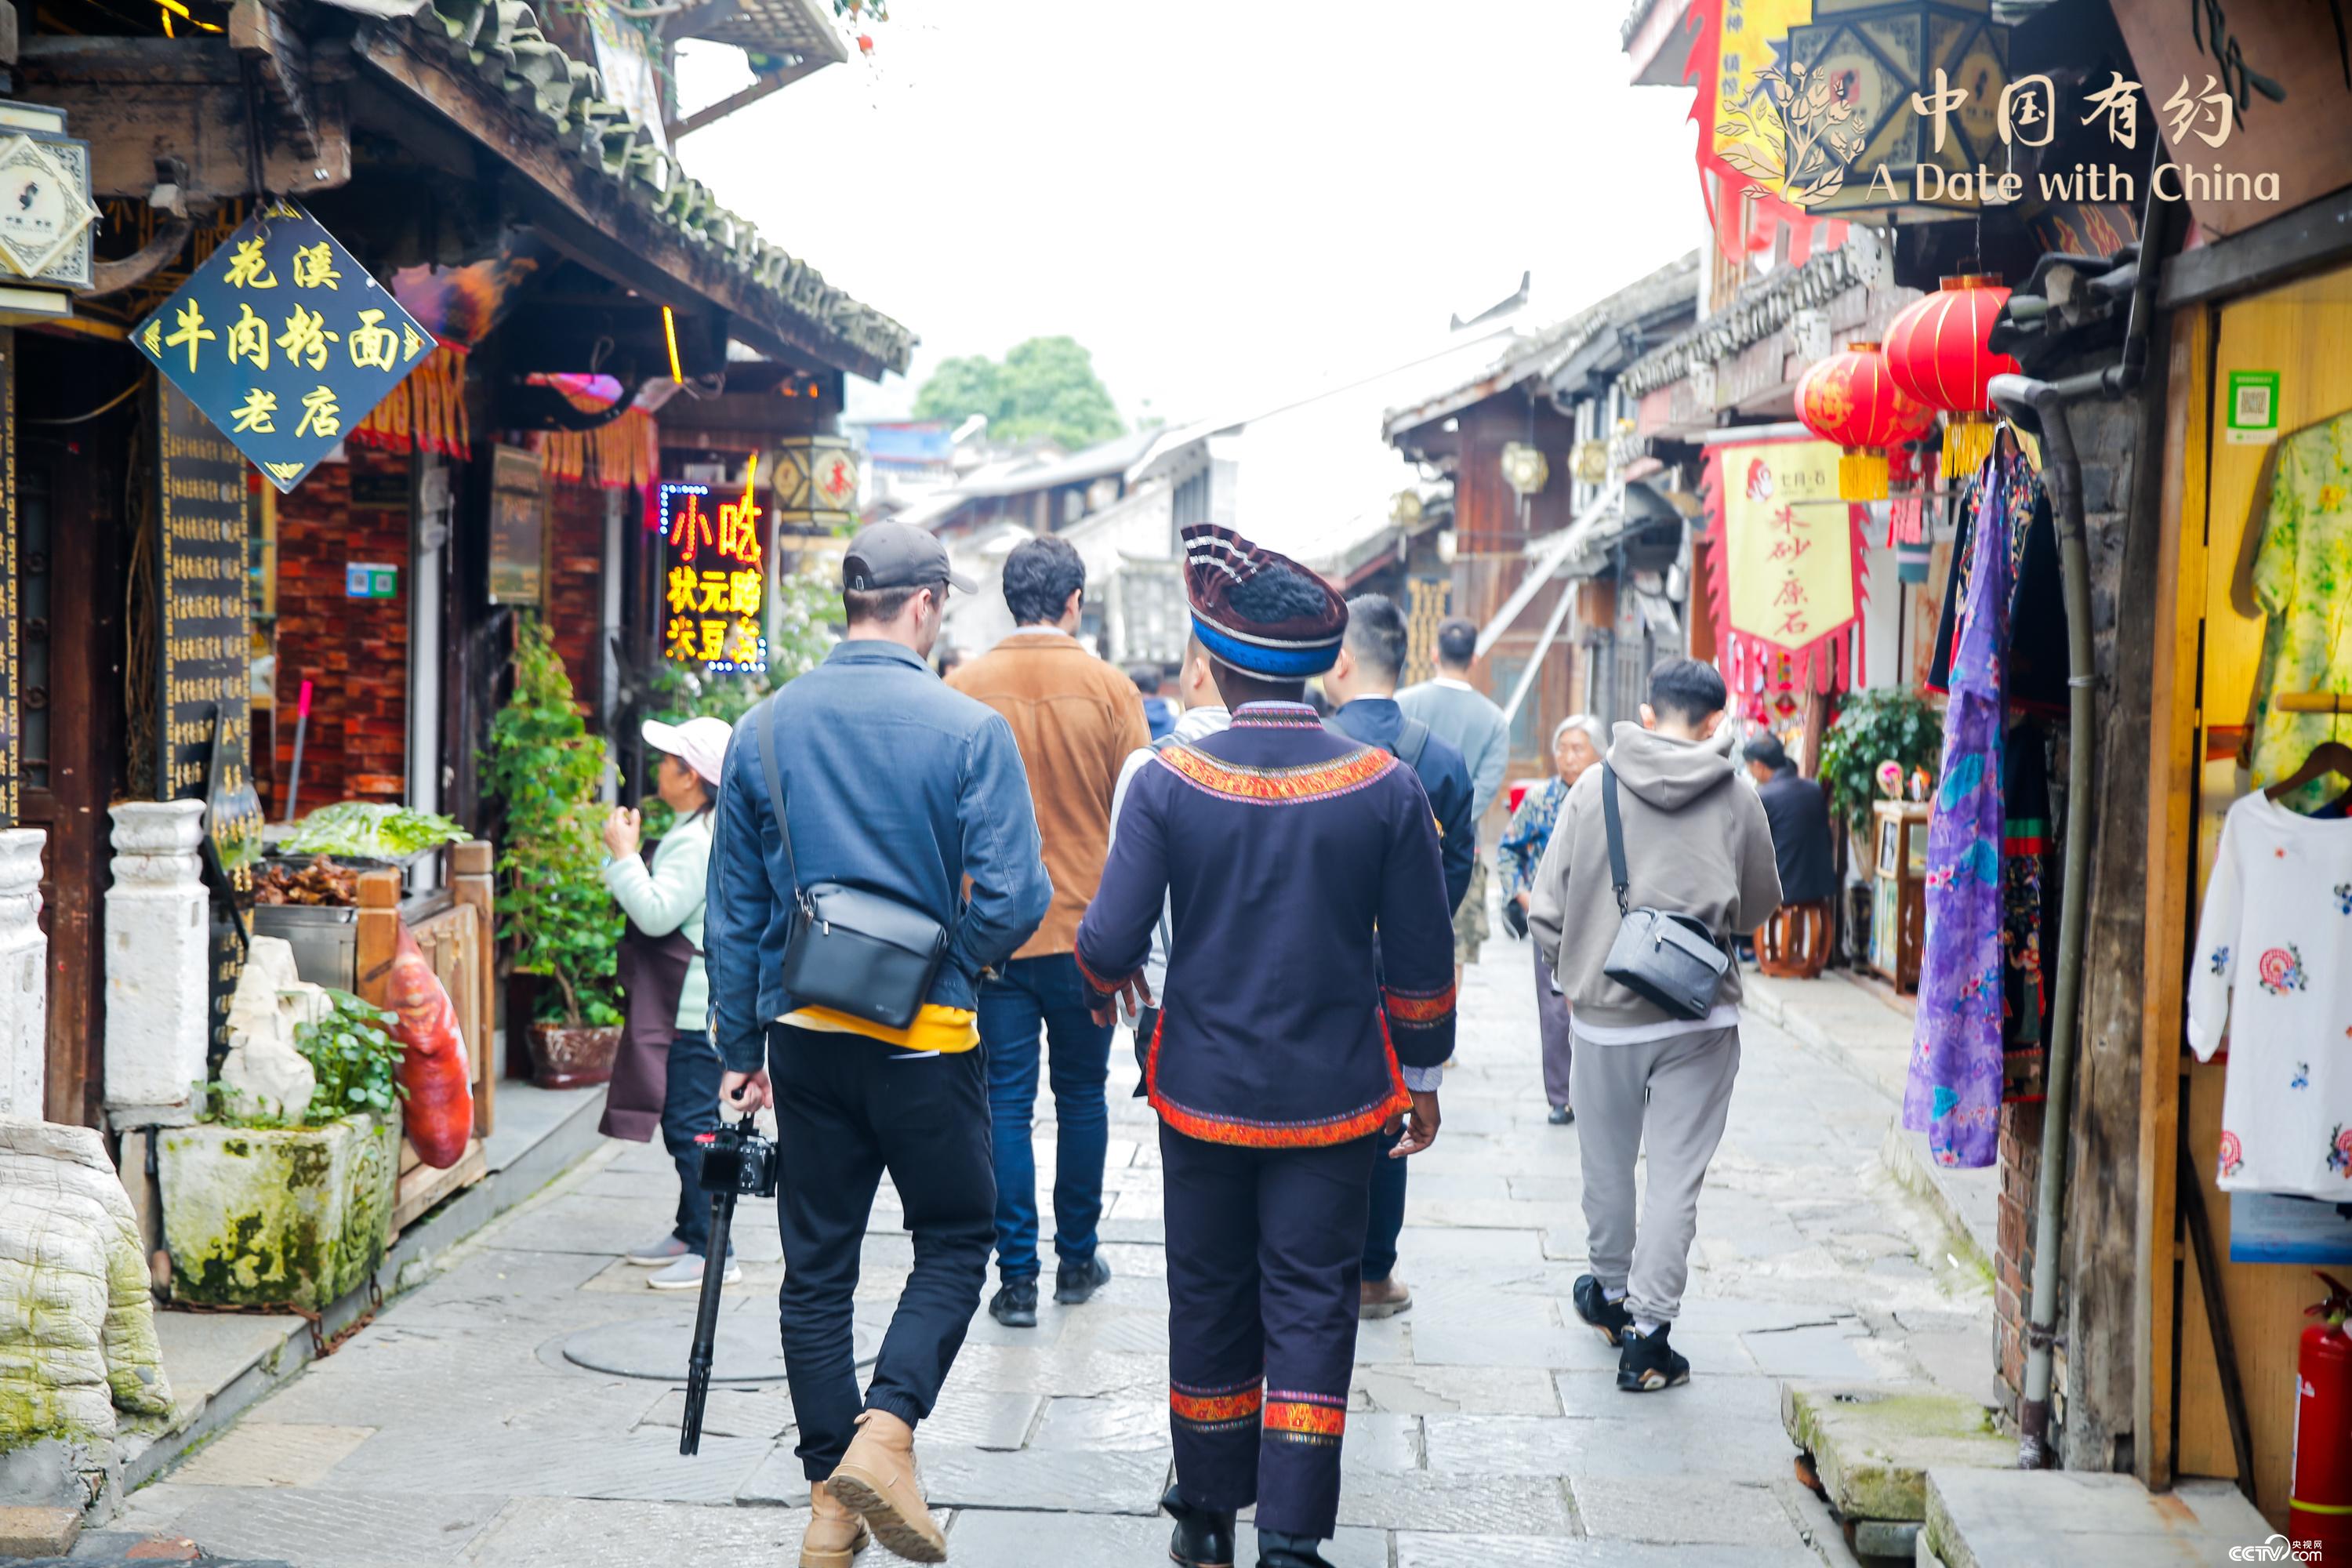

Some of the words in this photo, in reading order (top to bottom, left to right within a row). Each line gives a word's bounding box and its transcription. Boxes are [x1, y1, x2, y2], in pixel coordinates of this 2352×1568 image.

[223, 234, 343, 291] 花溪
[165, 297, 401, 373] 牛肉粉面
[230, 384, 342, 438] 老店
[670, 494, 763, 563] 小吃
